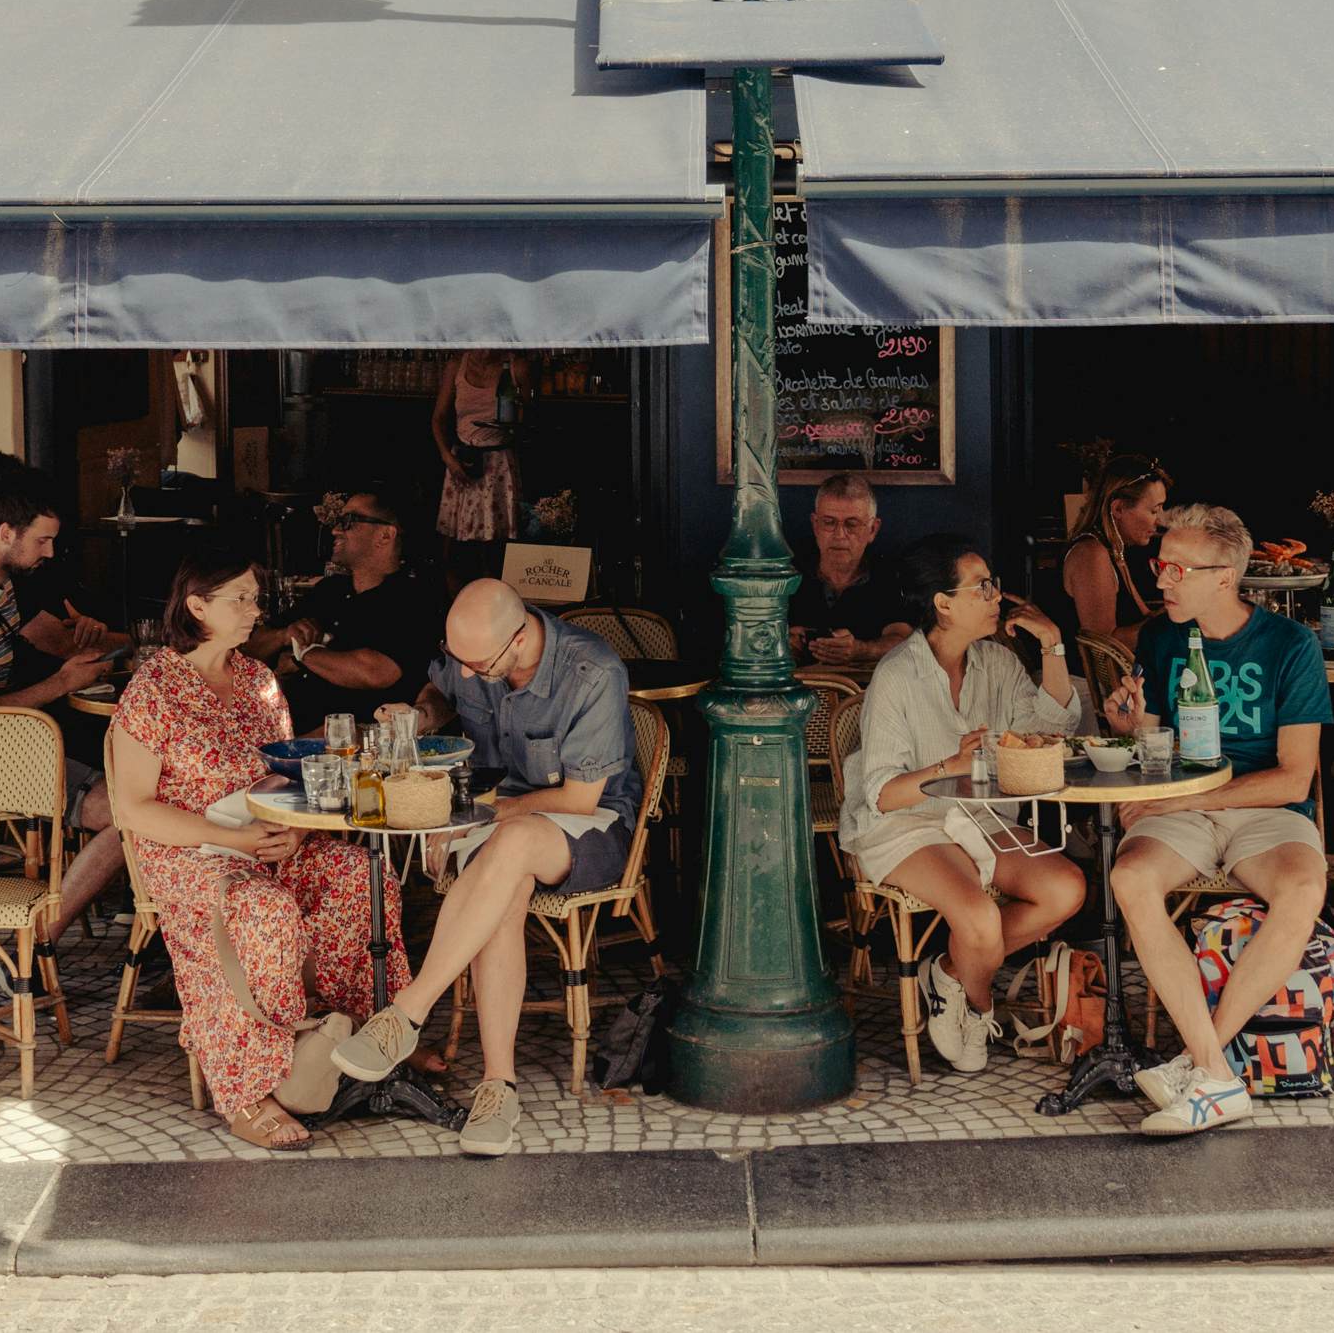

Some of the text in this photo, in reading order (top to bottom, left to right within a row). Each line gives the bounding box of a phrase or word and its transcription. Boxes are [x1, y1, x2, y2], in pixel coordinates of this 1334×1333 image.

[775, 290, 808, 318] teak
[844, 367, 865, 390] de
[805, 422, 865, 438] DESSERT
[525, 565, 571, 578] ROCHER
[528, 577, 573, 588] CANCALE
